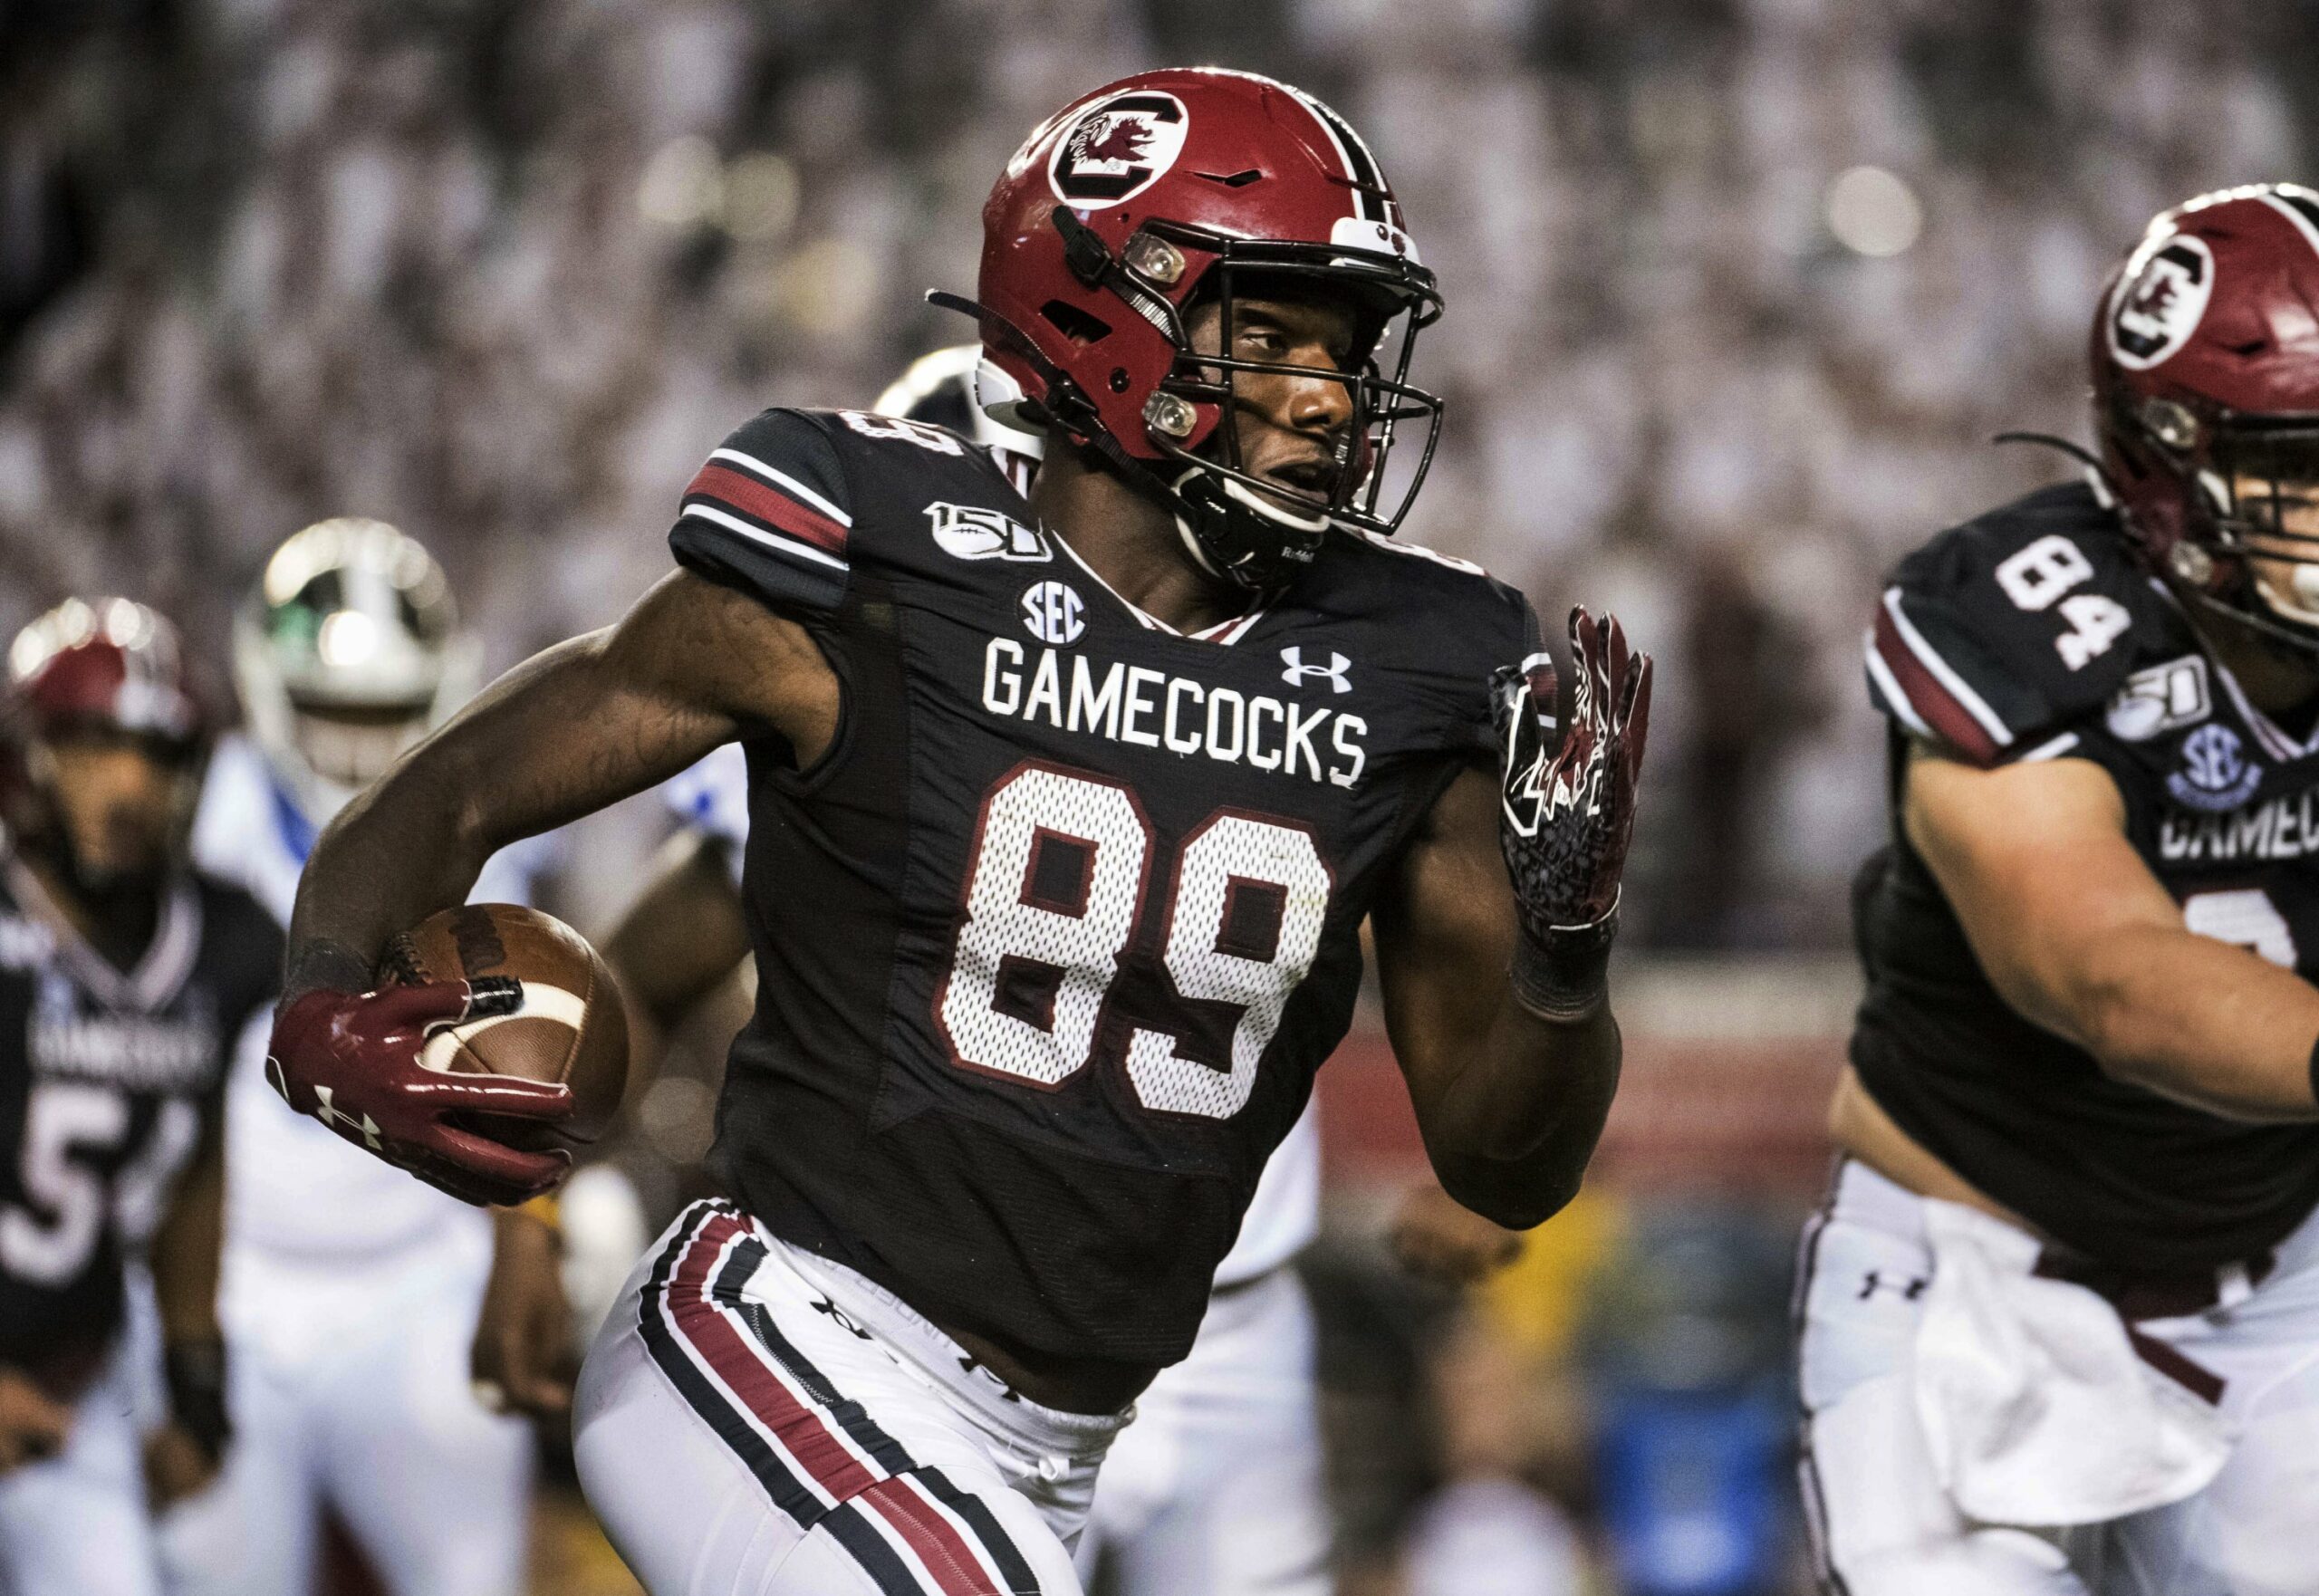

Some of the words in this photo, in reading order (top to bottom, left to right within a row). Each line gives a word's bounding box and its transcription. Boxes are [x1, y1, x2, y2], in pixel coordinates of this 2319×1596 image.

[1021, 581, 1086, 644] SEC
[1995, 534, 2131, 671] 84
[982, 637, 1369, 790] GAMECOCKS
[935, 759, 1336, 1120] 89
